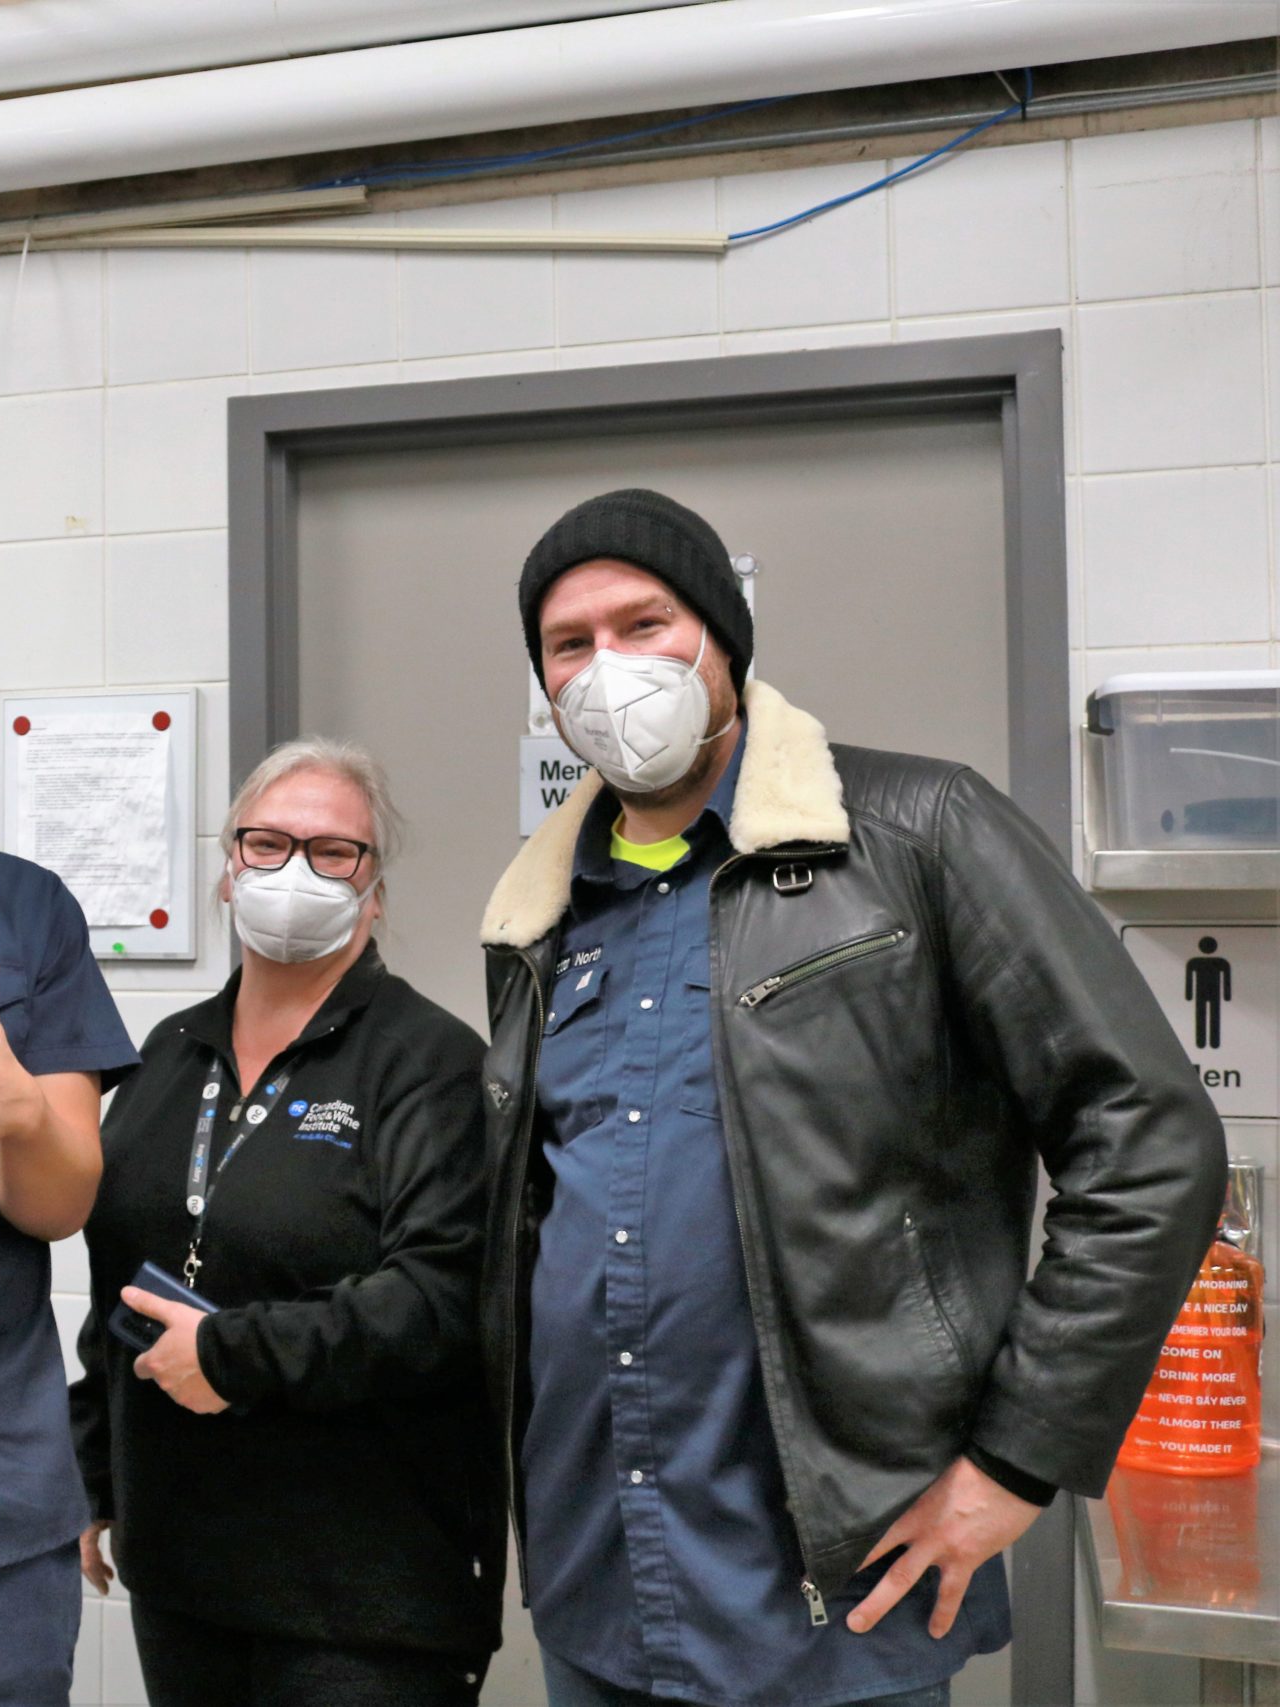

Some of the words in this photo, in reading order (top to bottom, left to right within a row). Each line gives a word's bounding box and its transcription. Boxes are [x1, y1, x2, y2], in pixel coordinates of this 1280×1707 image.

[1193, 1063, 1241, 1088] en
[309, 1099, 355, 1115] Canadian
[297, 1120, 341, 1134] Institute
[1199, 1280, 1248, 1289] MORNING
[1194, 1303, 1202, 1313] A
[1203, 1303, 1228, 1313] NICE
[1229, 1303, 1248, 1313] DAY
[1170, 1324, 1209, 1336] EMEMBER
[1210, 1326, 1231, 1337] YOUR
[1160, 1345, 1200, 1359] COME
[1202, 1349, 1222, 1360] ON
[1159, 1368, 1199, 1382] DRINK
[1201, 1372, 1237, 1383] MORE
[1158, 1392, 1193, 1405] NEVER
[1219, 1395, 1247, 1406] NEVER
[1158, 1415, 1208, 1430] ALMOST
[1210, 1419, 1242, 1430] THERE
[1159, 1440, 1186, 1452] YOU
[1188, 1442, 1221, 1454] MADE
[1223, 1443, 1233, 1454] IT
